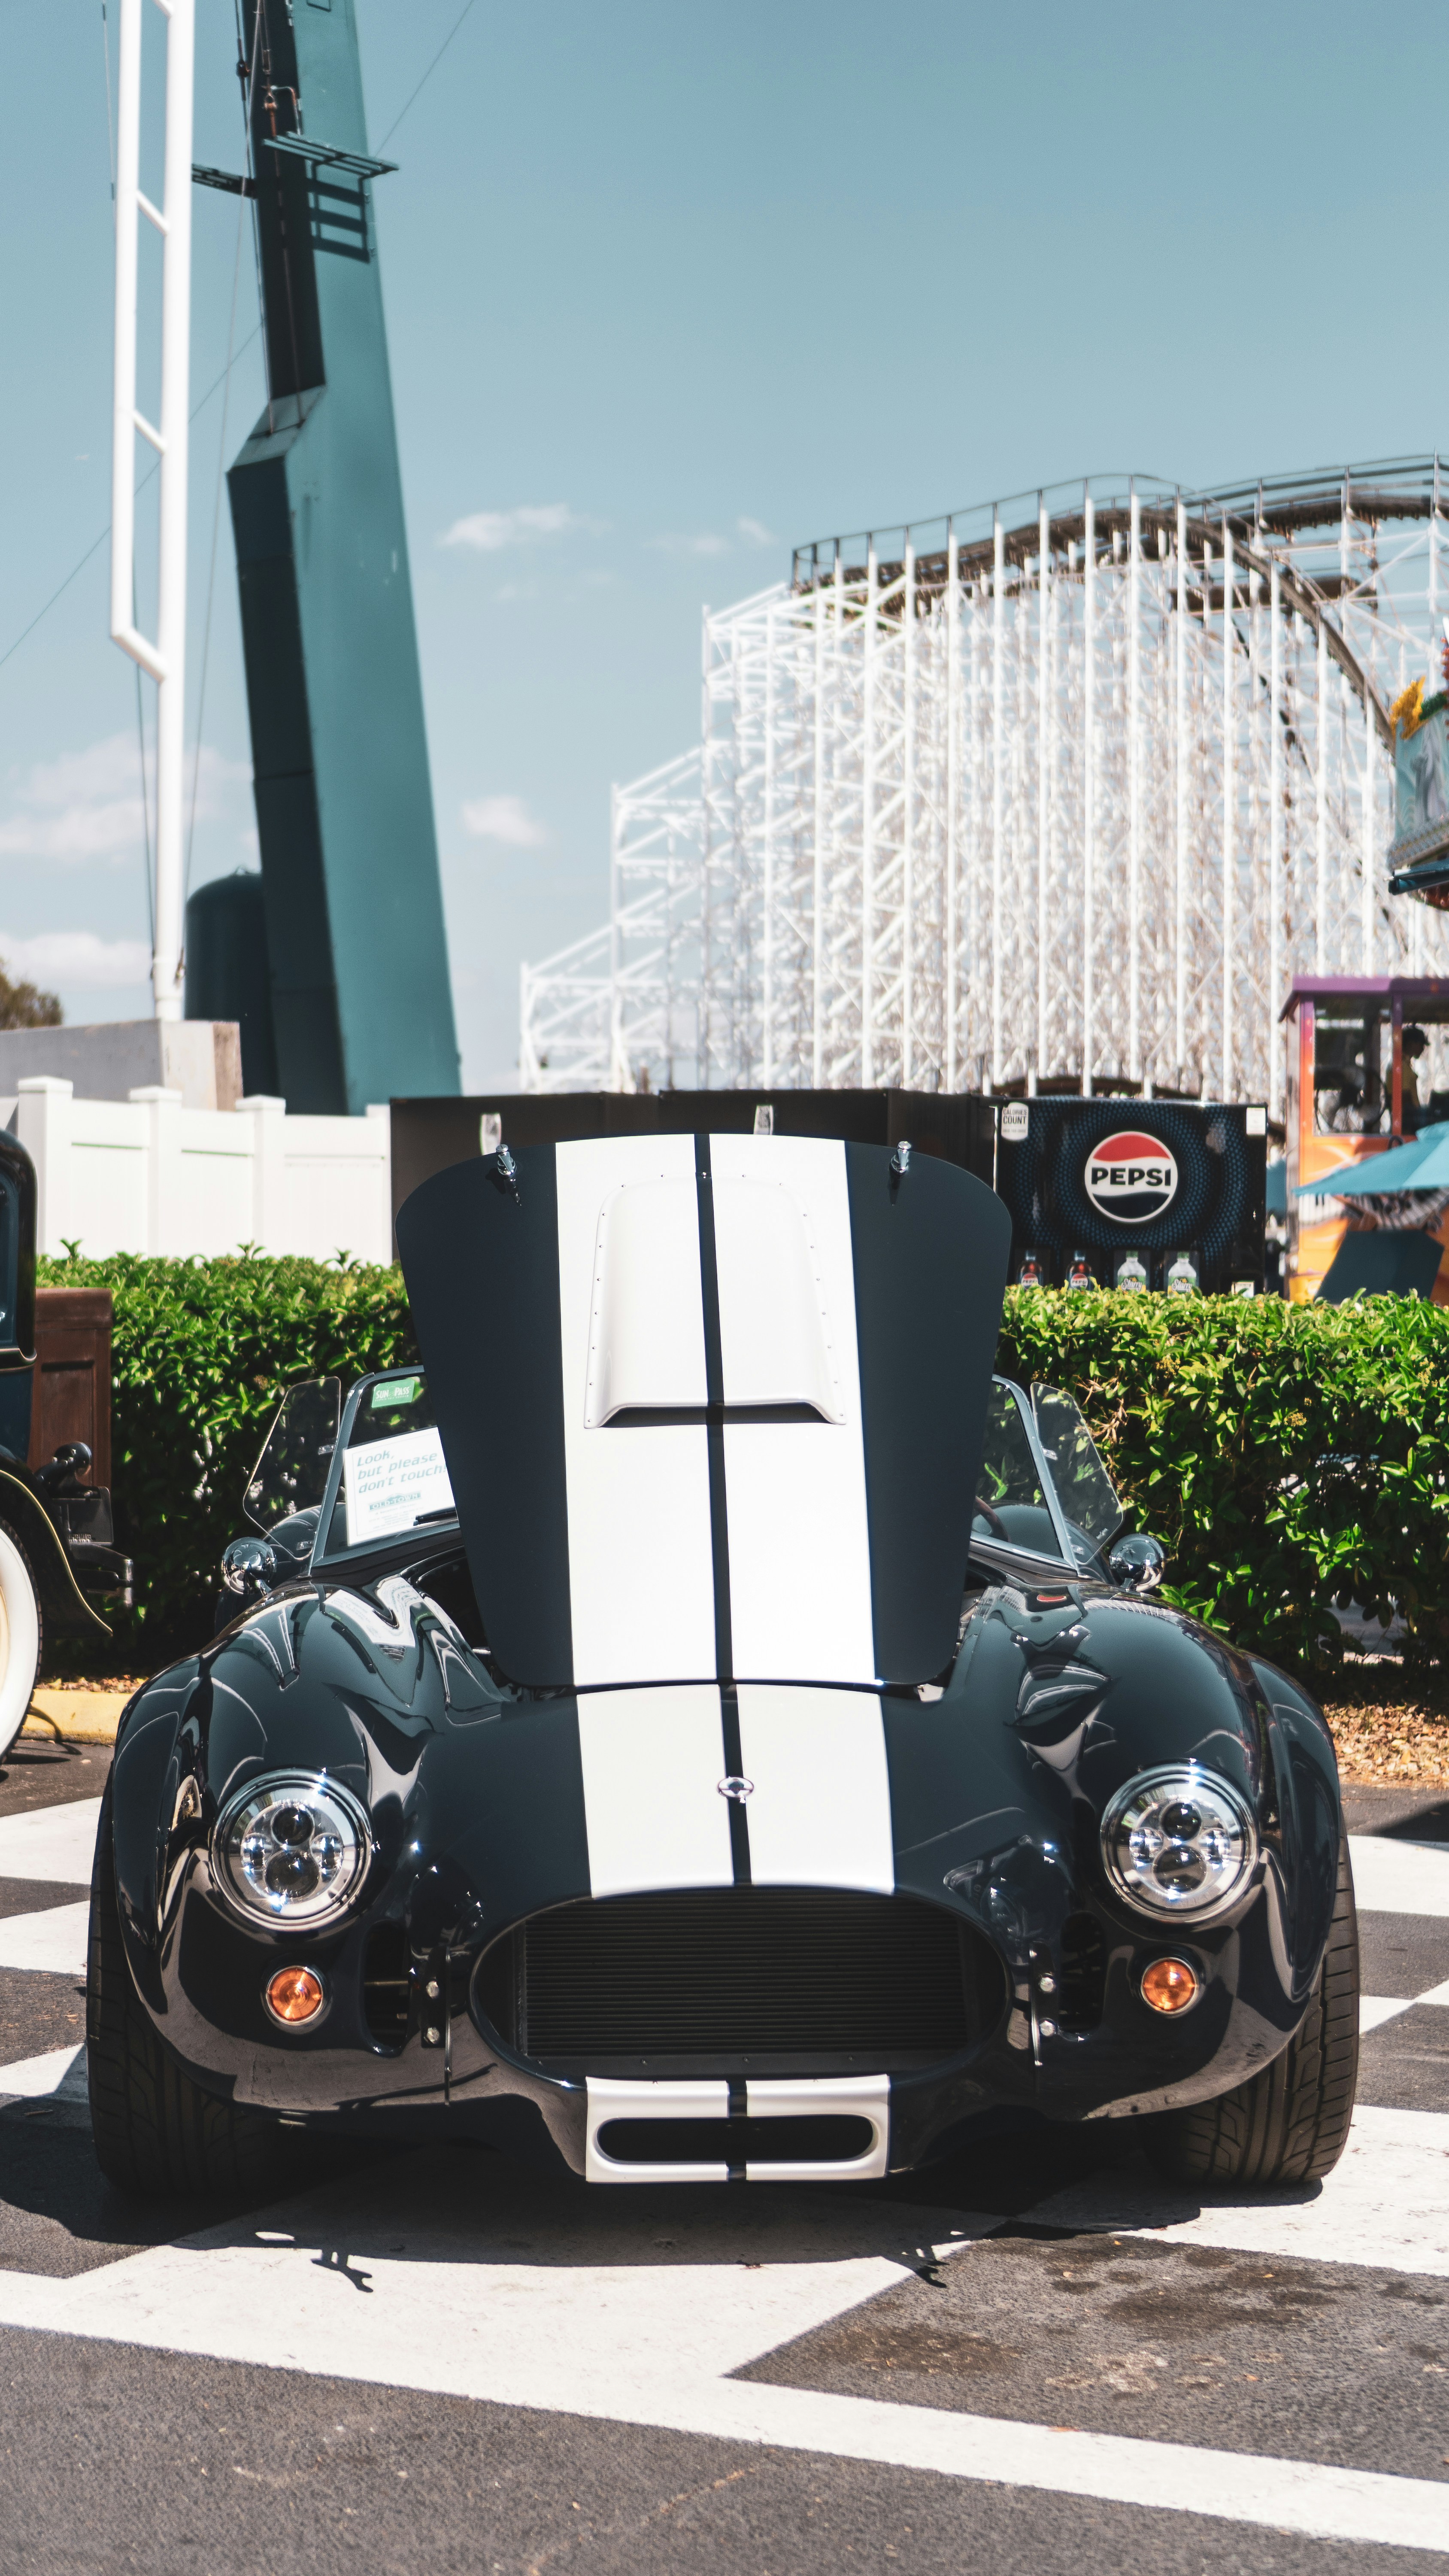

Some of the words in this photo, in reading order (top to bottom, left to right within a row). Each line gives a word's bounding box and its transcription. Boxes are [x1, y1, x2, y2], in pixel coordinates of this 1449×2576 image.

[1003, 1115, 1027, 1124] COUNT
[1091, 1167, 1171, 1186] PEPSI
[376, 1389, 389, 1399] SUN
[394, 1386, 410, 1396] PASS
[357, 1450, 394, 1467] Look,
[358, 1465, 382, 1479] but
[388, 1453, 437, 1473] please
[359, 1476, 394, 1493] don't
[400, 1464, 446, 1482] touch!
